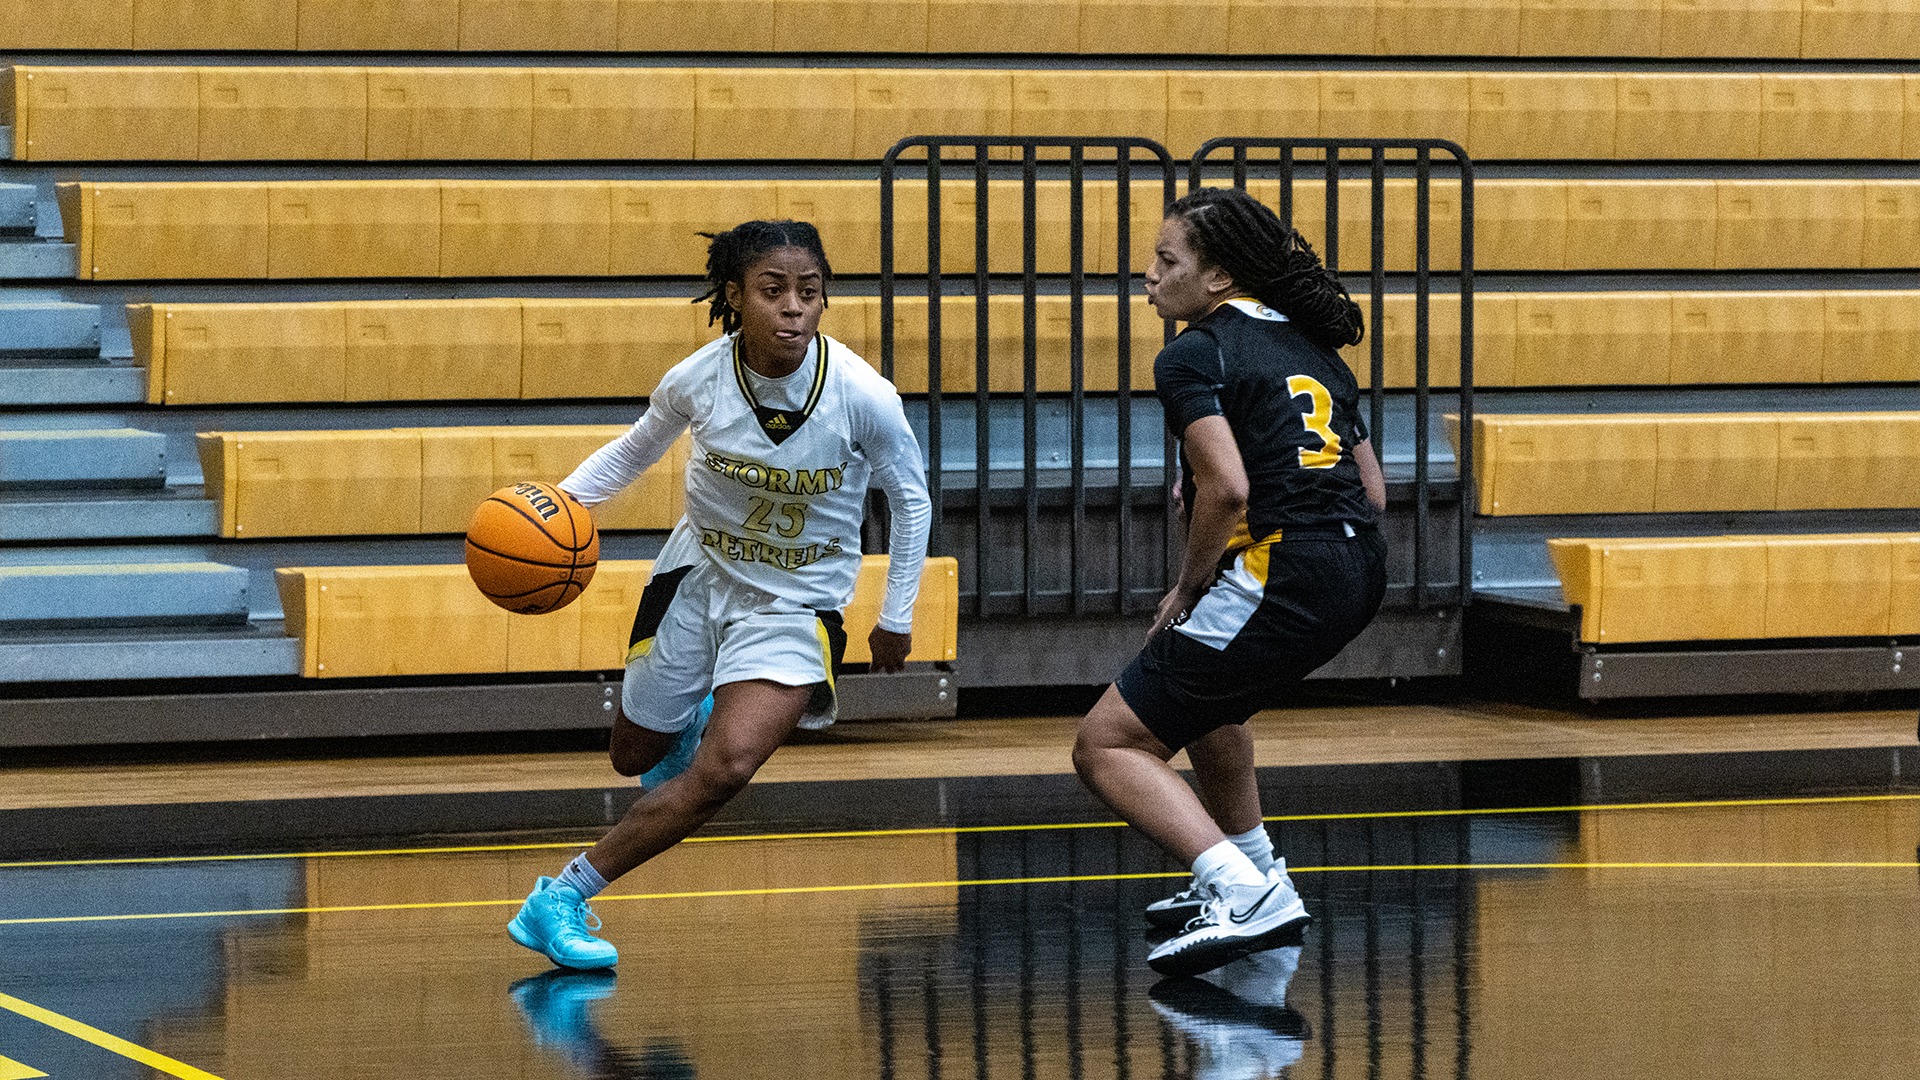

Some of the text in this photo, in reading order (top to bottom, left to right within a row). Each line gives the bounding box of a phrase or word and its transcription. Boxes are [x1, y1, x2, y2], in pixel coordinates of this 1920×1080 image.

[765, 422, 791, 430] adidas
[1286, 374, 1343, 469] 3
[705, 452, 848, 495] STORMY
[741, 496, 808, 538] 25
[700, 526, 842, 570] PETRELS
